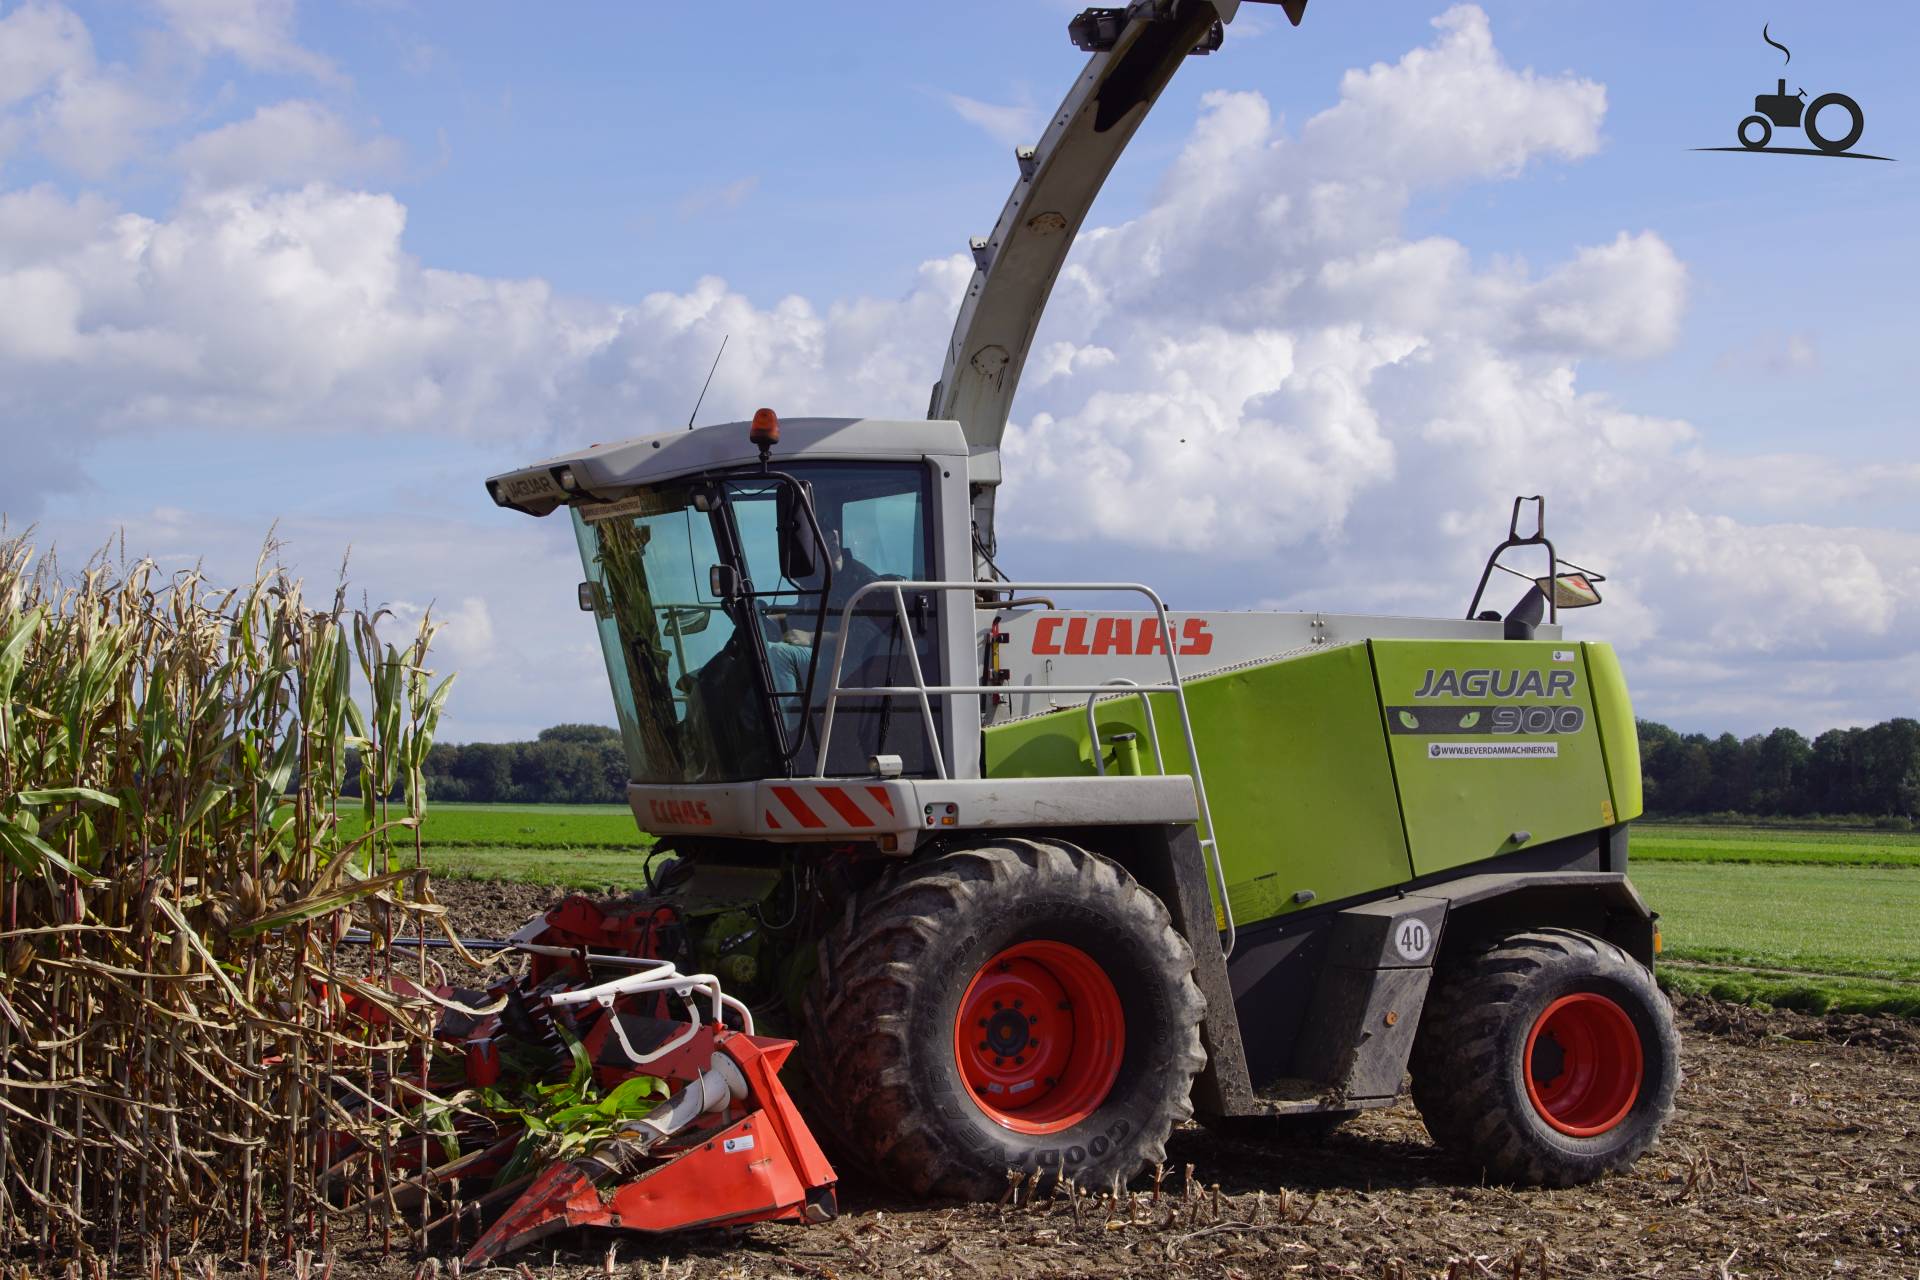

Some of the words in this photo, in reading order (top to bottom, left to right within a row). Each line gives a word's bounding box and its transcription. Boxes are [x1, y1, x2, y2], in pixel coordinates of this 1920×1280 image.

[507, 477, 553, 498] JAGUAR
[1032, 617, 1213, 655] CLAAS
[1414, 668, 1576, 699] JAGUAR
[1491, 705, 1585, 735] 900
[1441, 744, 1556, 756] WWW.BEVERDAMMACHINERY.NL
[651, 799, 712, 825] CLAAS
[1401, 925, 1424, 952] 40
